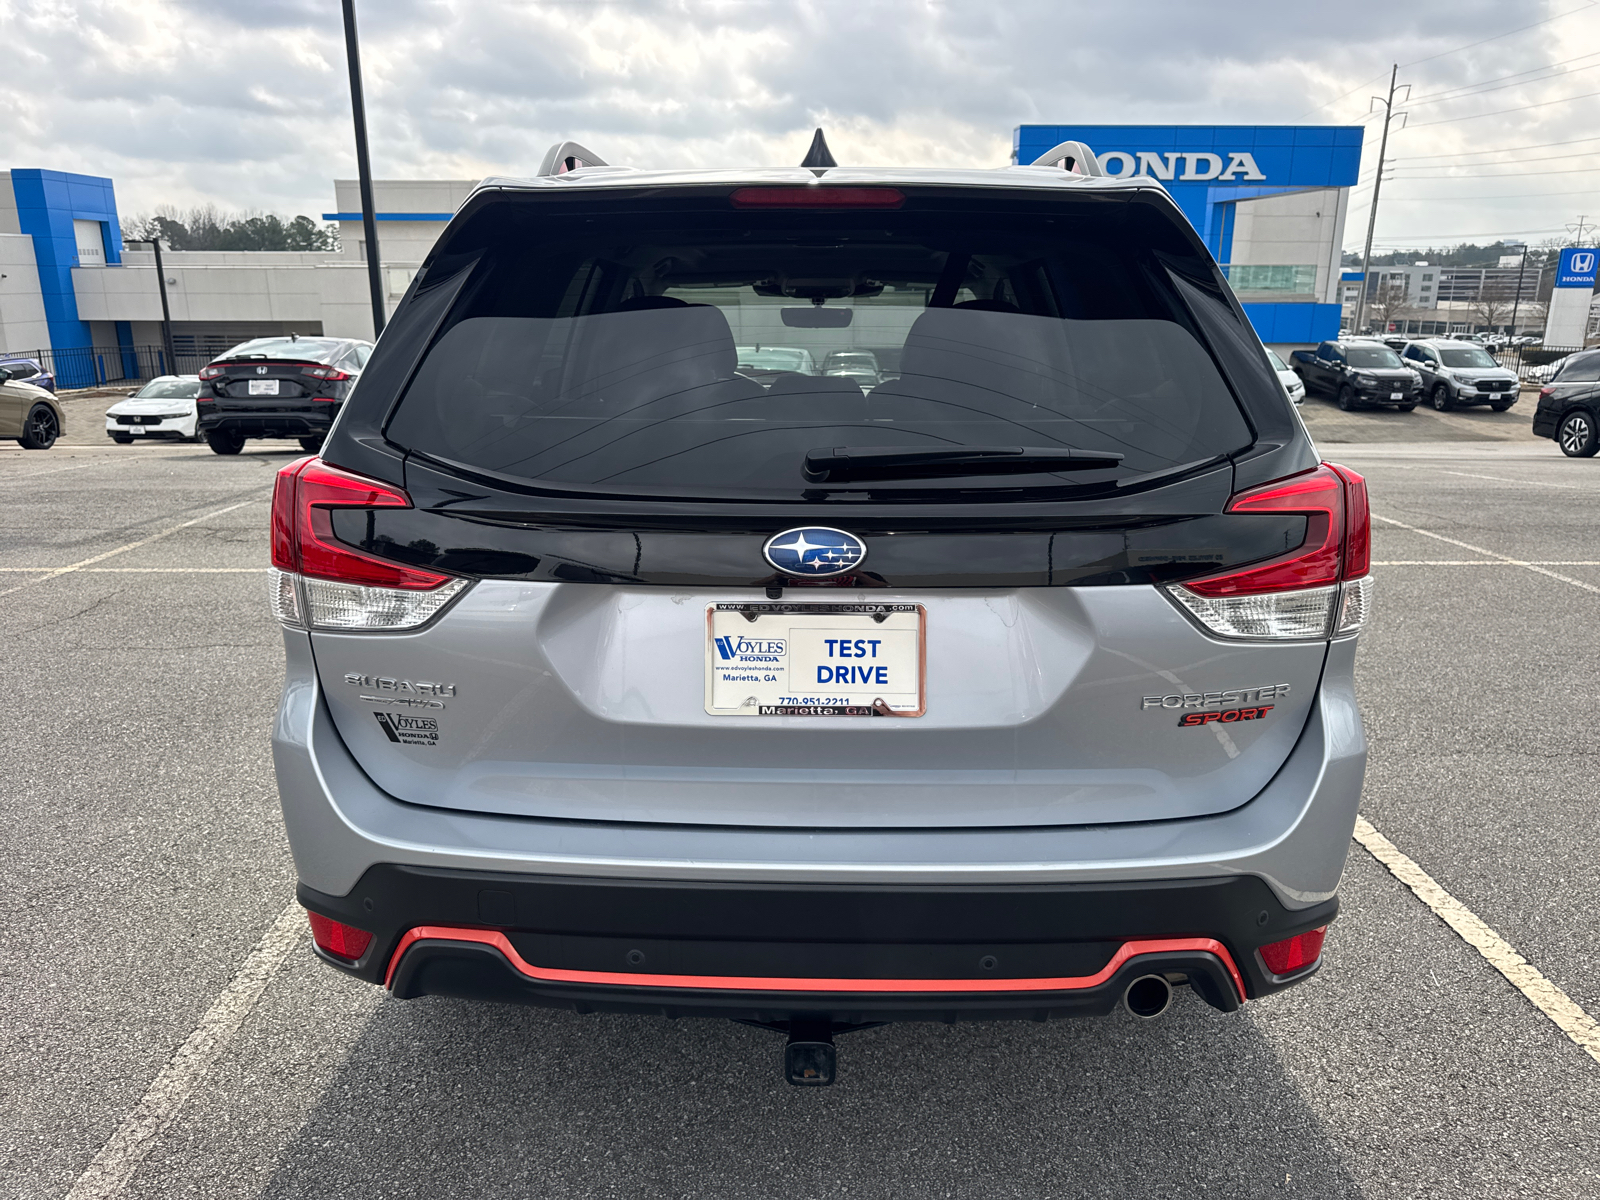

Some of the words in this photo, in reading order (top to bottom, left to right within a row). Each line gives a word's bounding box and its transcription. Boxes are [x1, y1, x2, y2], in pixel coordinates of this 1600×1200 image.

[1098, 151, 1267, 181] ONDA
[824, 639, 882, 658] TEST
[723, 674, 761, 682] Marietta,
[764, 674, 777, 682] GA
[817, 665, 888, 684] DRIVE
[344, 672, 456, 697] SUBARU
[778, 697, 850, 705] 770-951-2211
[1141, 683, 1291, 710] FORESTER
[761, 706, 839, 715] Marietta,
[844, 706, 870, 715] GA
[1179, 704, 1275, 727] SPORT
